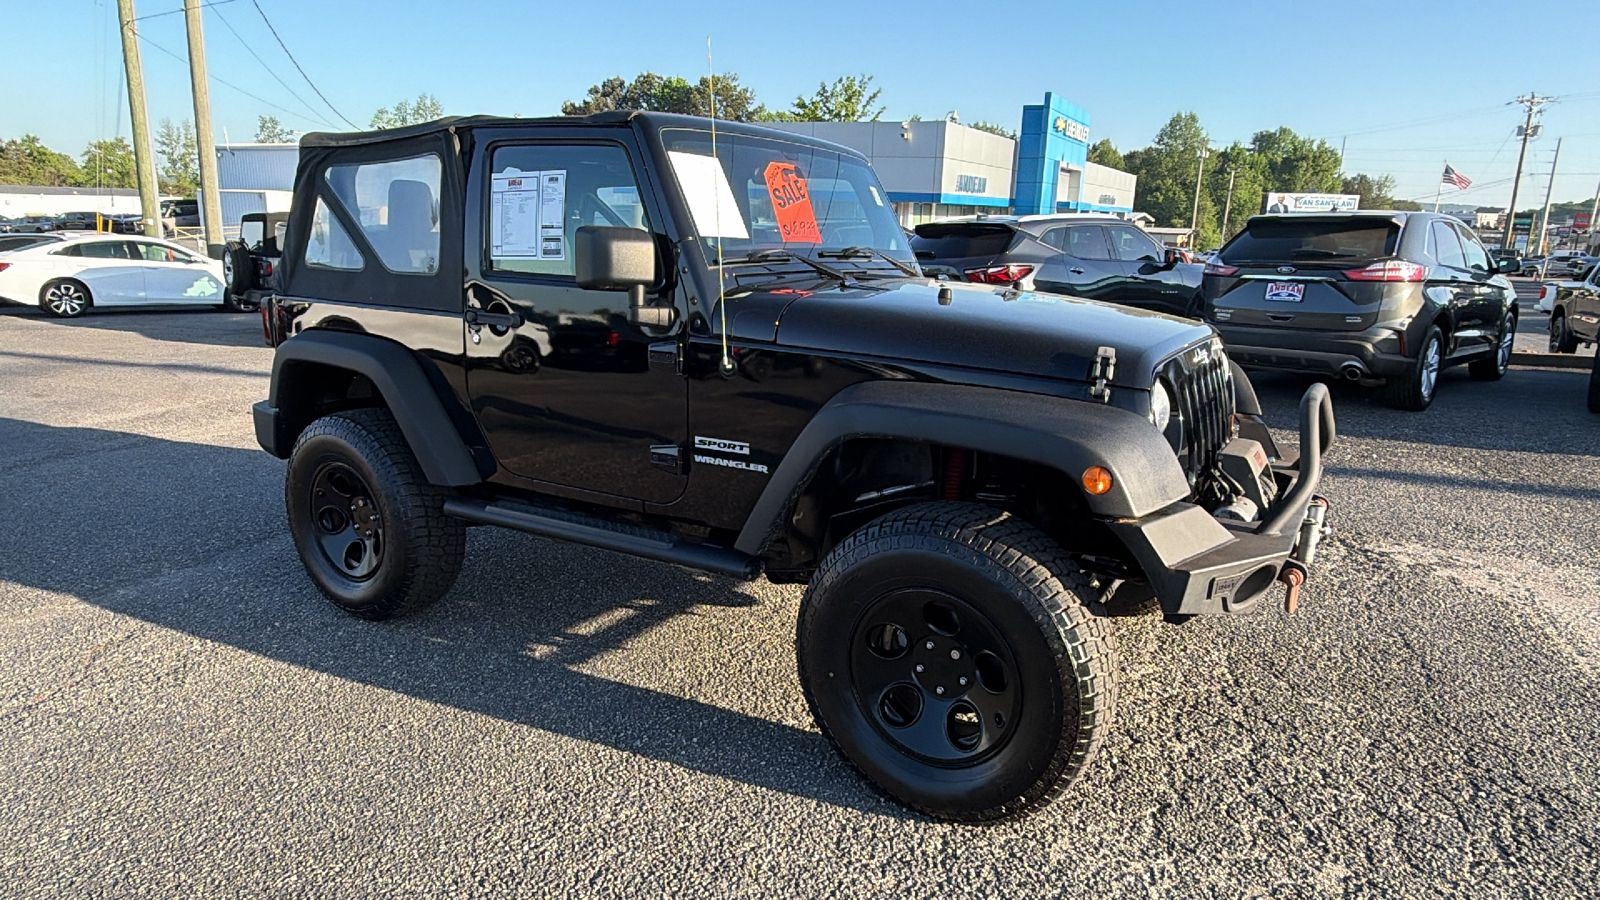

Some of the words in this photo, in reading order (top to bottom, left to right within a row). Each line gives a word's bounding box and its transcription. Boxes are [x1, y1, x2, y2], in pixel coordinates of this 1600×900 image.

[773, 180, 807, 209] SALE
[1336, 200, 1353, 208] LAW
[1268, 285, 1303, 295] ANDEAN
[696, 439, 749, 451] SPORT
[694, 454, 768, 474] WRANGLER
